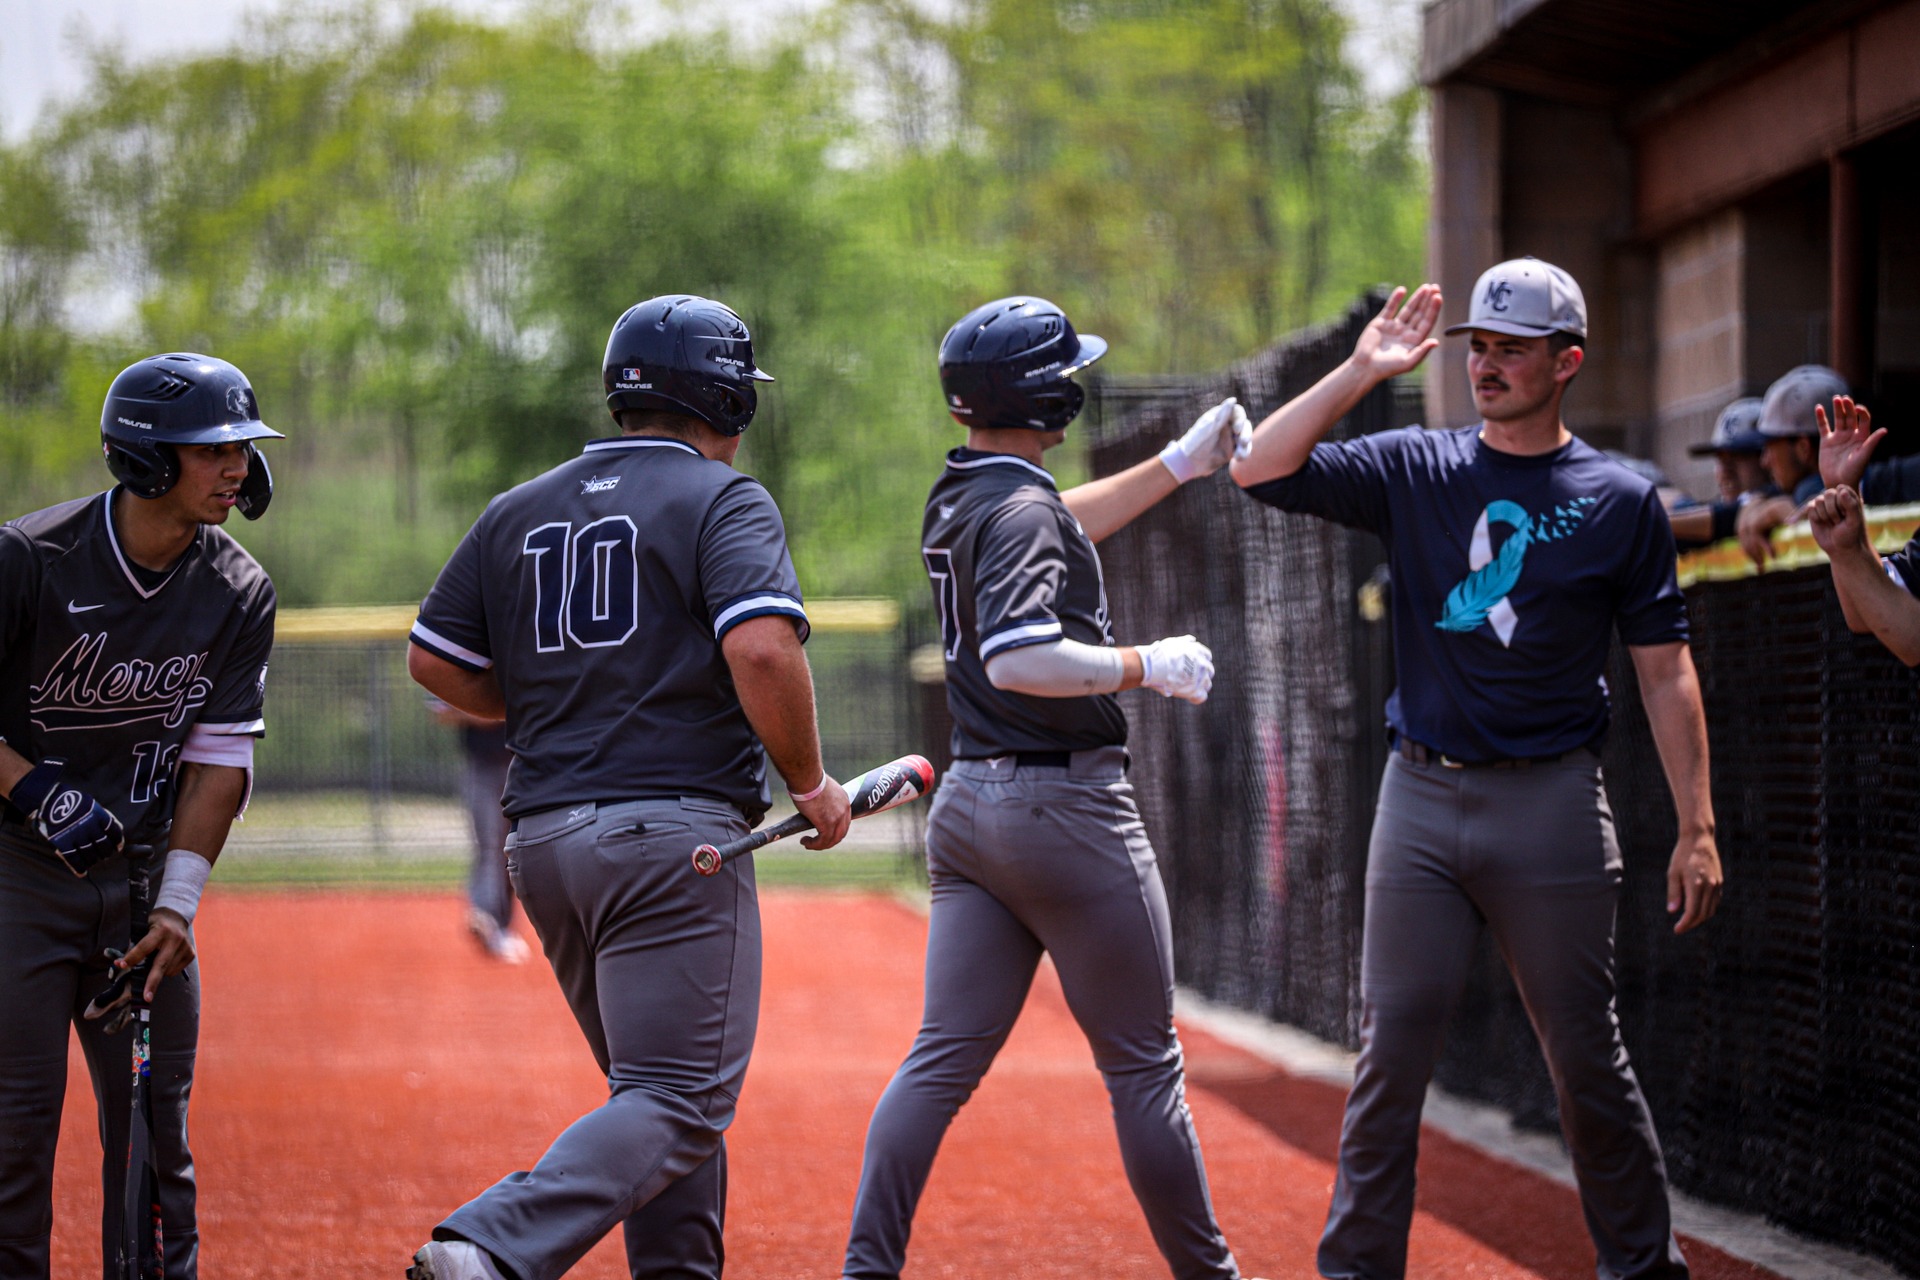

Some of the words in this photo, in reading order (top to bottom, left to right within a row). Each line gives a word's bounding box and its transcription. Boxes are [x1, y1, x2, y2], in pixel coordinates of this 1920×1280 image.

[1483, 281, 1512, 312] MC
[523, 515, 639, 653] 10
[30, 631, 213, 729] Mercy
